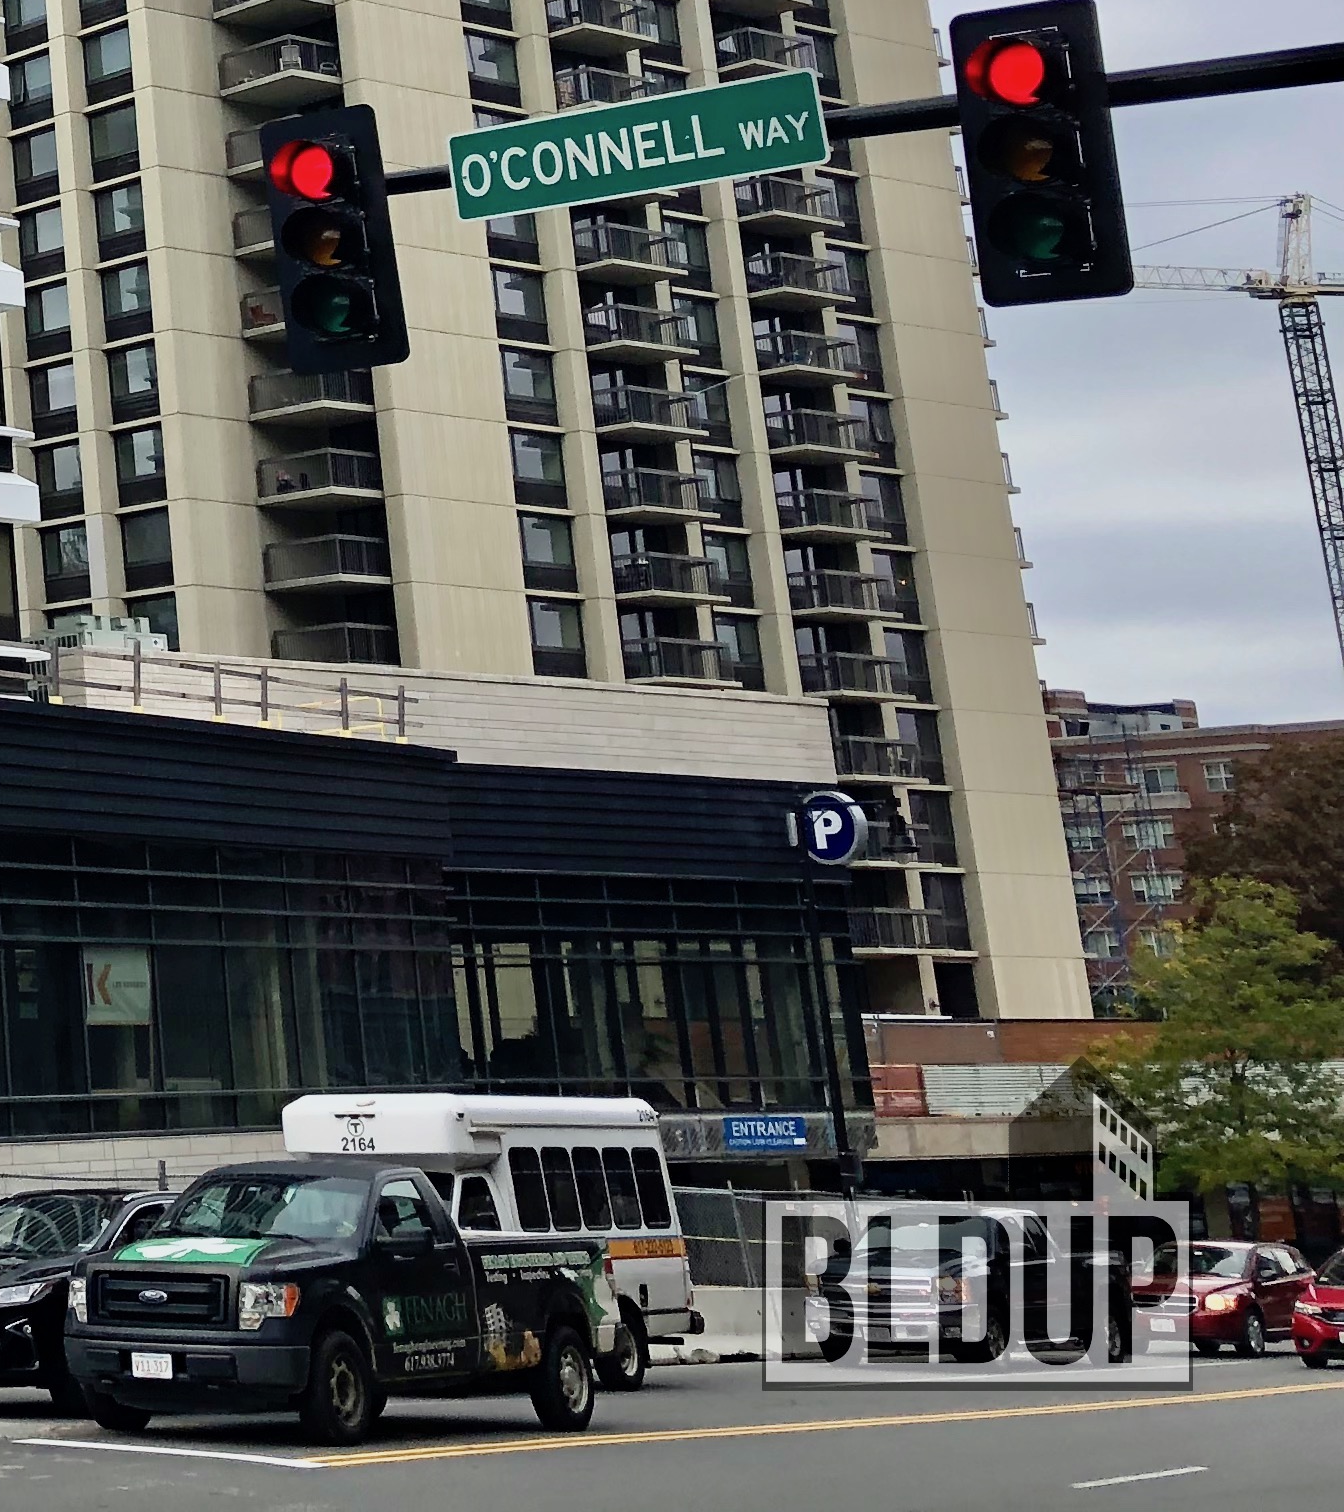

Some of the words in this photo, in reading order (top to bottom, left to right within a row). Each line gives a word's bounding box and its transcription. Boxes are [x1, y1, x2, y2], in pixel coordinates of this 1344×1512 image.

[461, 114, 725, 198] O'CONNELL
[737, 111, 809, 150] WAY
[811, 810, 842, 849] P
[341, 1137, 375, 1151] 2164
[731, 1121, 797, 1137] ENTRANCE
[404, 1293, 467, 1324] FENAGH
